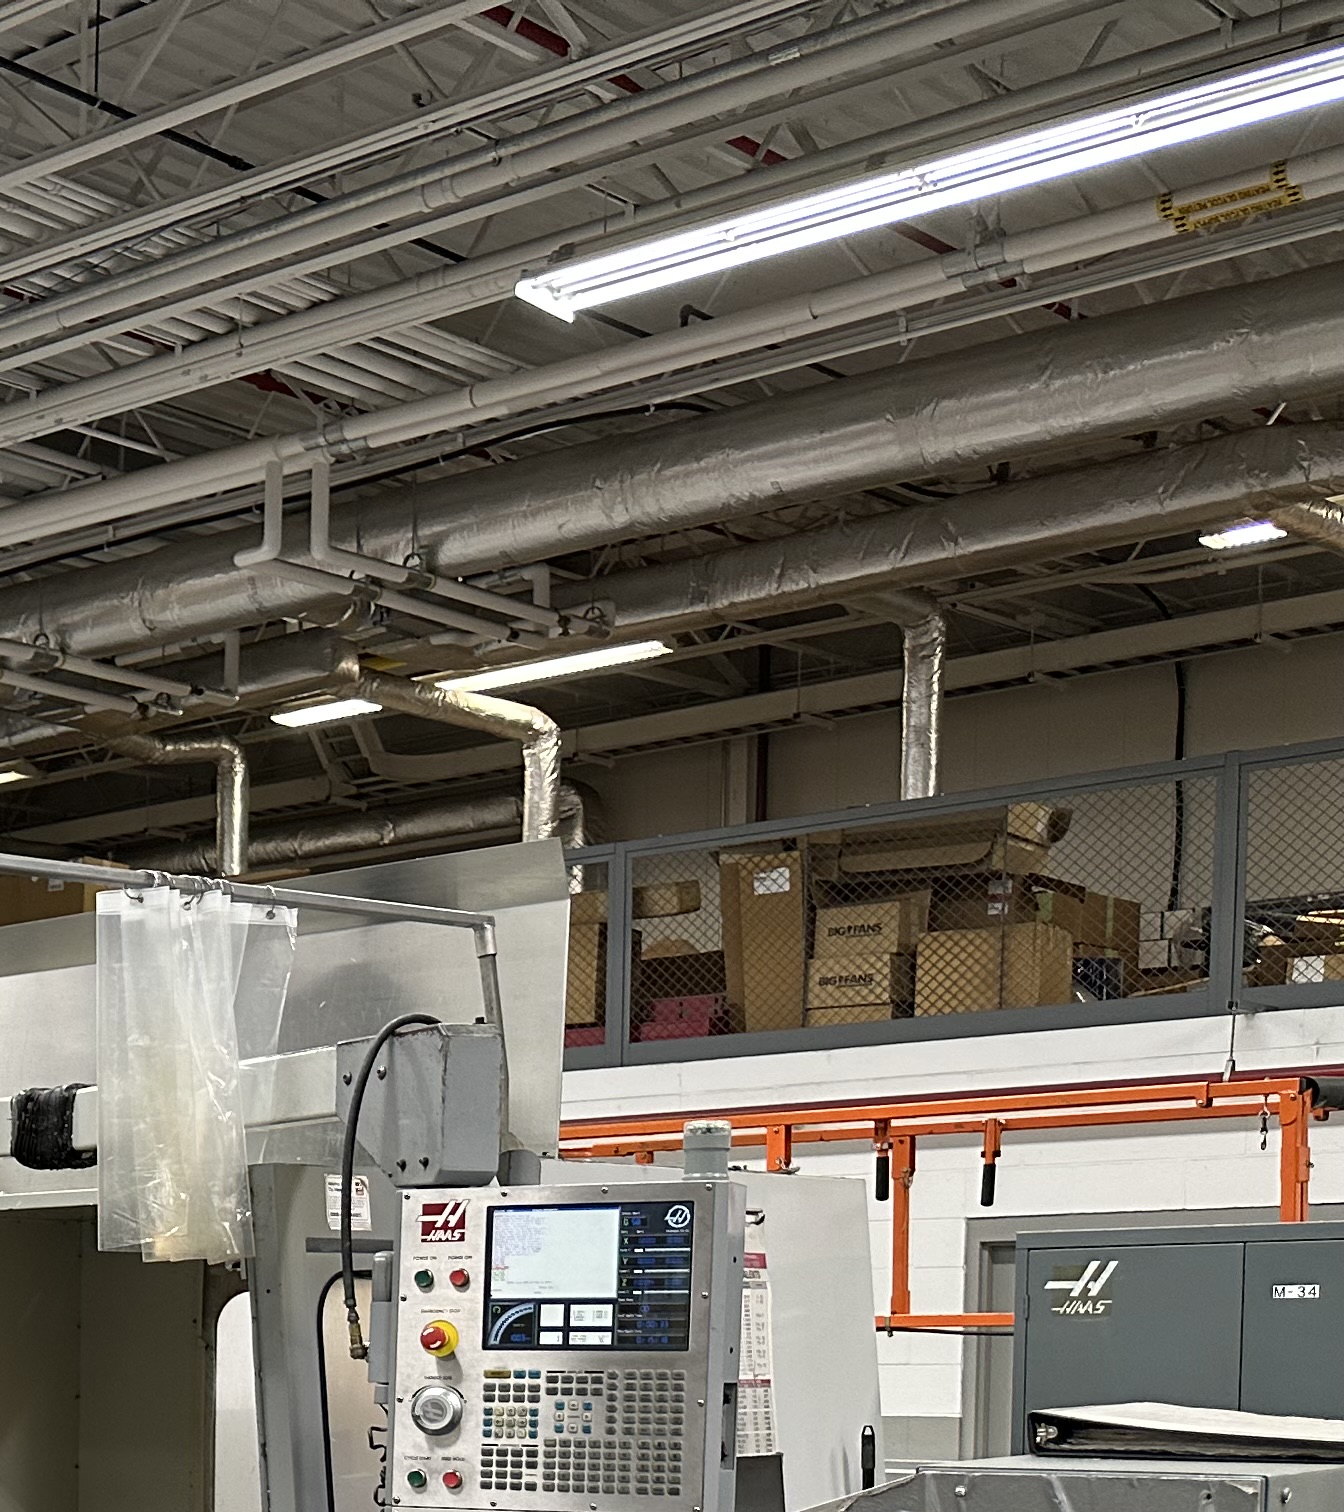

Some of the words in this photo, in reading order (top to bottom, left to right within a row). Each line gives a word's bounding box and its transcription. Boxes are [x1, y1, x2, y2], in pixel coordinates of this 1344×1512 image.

[421, 1229, 466, 1242] HAAS
[1274, 1286, 1317, 1298] M-34
[1051, 1300, 1112, 1315] HAAS
